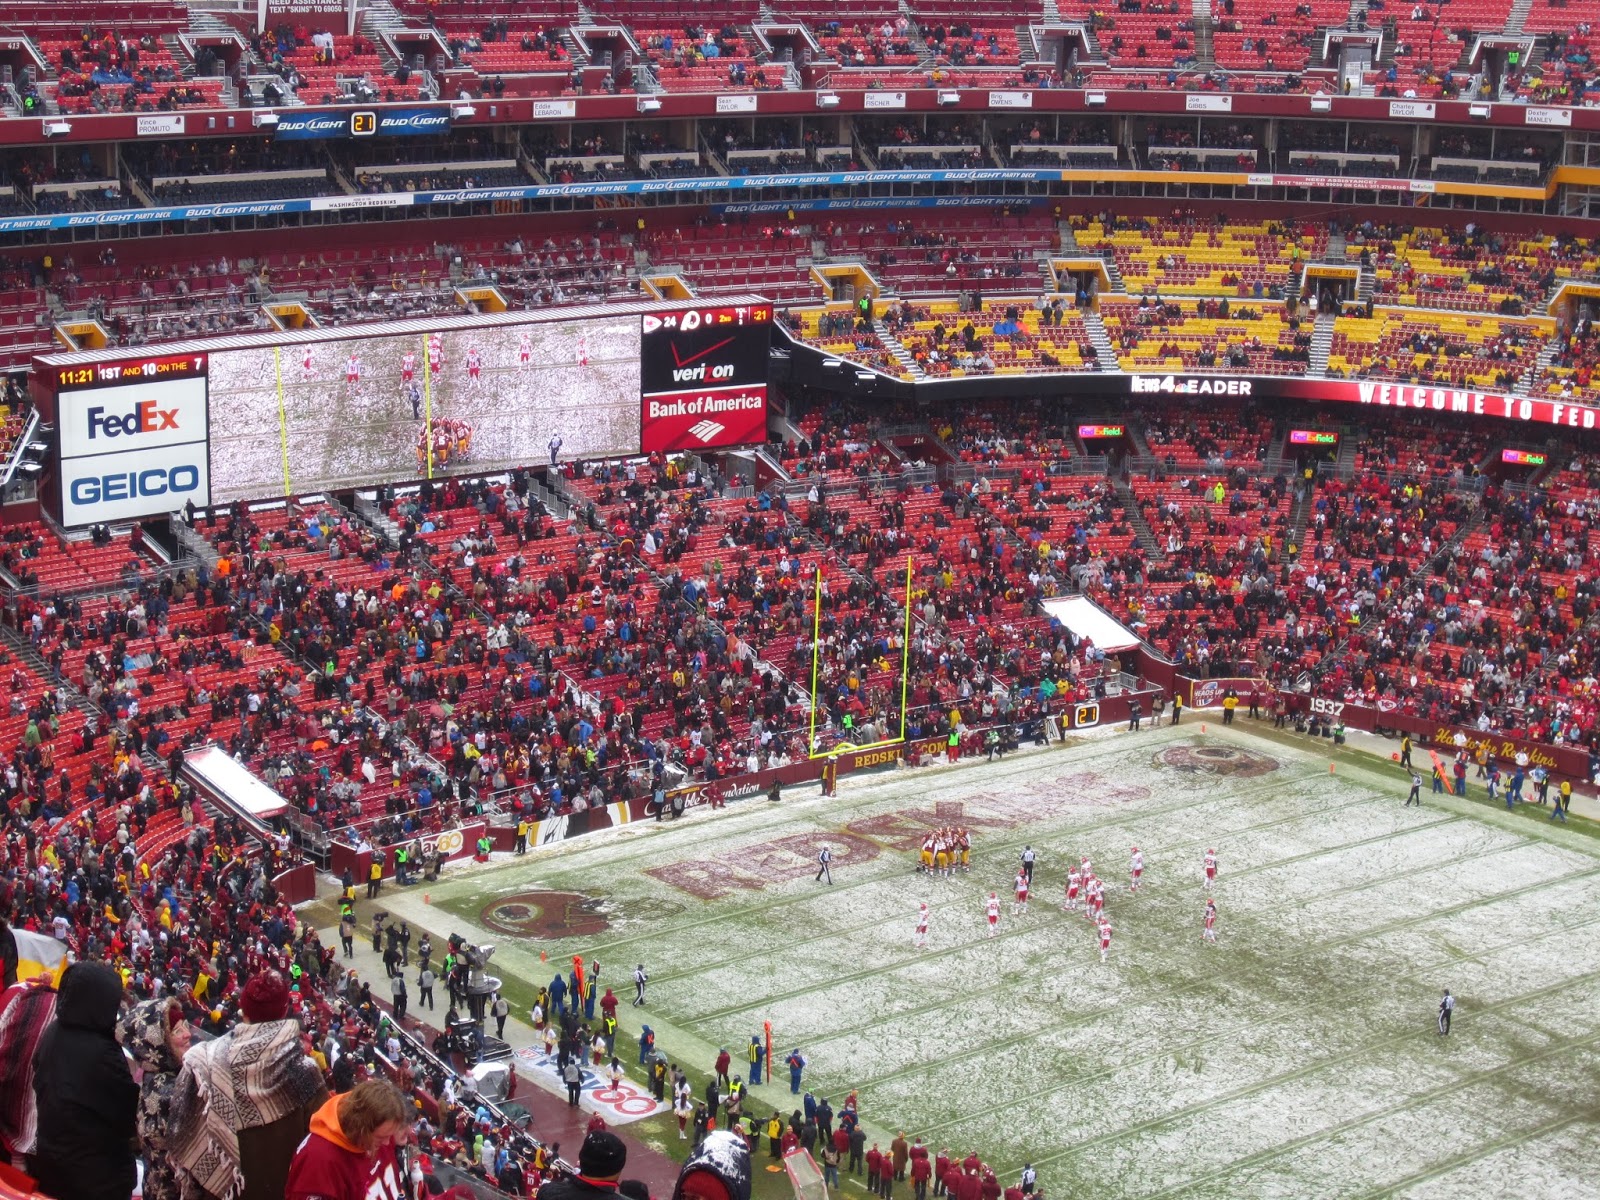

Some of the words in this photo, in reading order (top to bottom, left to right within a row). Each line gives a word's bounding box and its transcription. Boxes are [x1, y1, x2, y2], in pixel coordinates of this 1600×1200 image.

[1391, 103, 1415, 111] Charley
[139, 118, 157, 126] Vince
[277, 122, 305, 131] BUD
[309, 120, 346, 129] LIGHT
[354, 116, 373, 131] 21
[380, 118, 408, 127] BUD
[412, 116, 449, 125] LIGHT
[138, 125, 171, 133] PROMUTO
[843, 174, 866, 182] BUD
[868, 173, 898, 181] LIGHT
[971, 171, 1002, 179] LIGHT
[668, 181, 697, 189] LIGHT
[742, 178, 767, 186] BUD
[432, 193, 457, 201] BUD
[461, 191, 491, 199] LIGHT
[536, 188, 562, 196] BUD
[564, 186, 595, 194] LIGHT
[185, 209, 211, 217] BUD
[215, 206, 248, 215] LIGHT
[13, 220, 34, 228] PARTY
[69, 216, 94, 225] BUD
[100, 213, 133, 222] LIGHT
[664, 316, 677, 327] 24
[705, 313, 713, 324] 0
[59, 369, 93, 384] 11:21
[100, 367, 121, 379] 1ST
[122, 367, 141, 376] AND
[141, 363, 157, 376] 10
[156, 364, 170, 372] ON
[171, 362, 187, 371] THE
[194, 358, 202, 370] 7
[673, 363, 734, 383] verizon
[649, 399, 687, 418] Bank
[687, 397, 703, 414] of
[703, 394, 762, 413] America
[1358, 383, 1485, 415] WELCOME
[1503, 397, 1533, 420] TO
[1552, 404, 1596, 429] FED
[87, 400, 180, 439] FedEx
[70, 464, 199, 506] GEICO
[1194, 689, 1214, 697] HEADS
[1310, 697, 1344, 716] 1937
[1079, 707, 1096, 723] 21
[438, 831, 463, 853] 60
[592, 1084, 657, 1115] 60
[527, 1176, 535, 1186] 10
